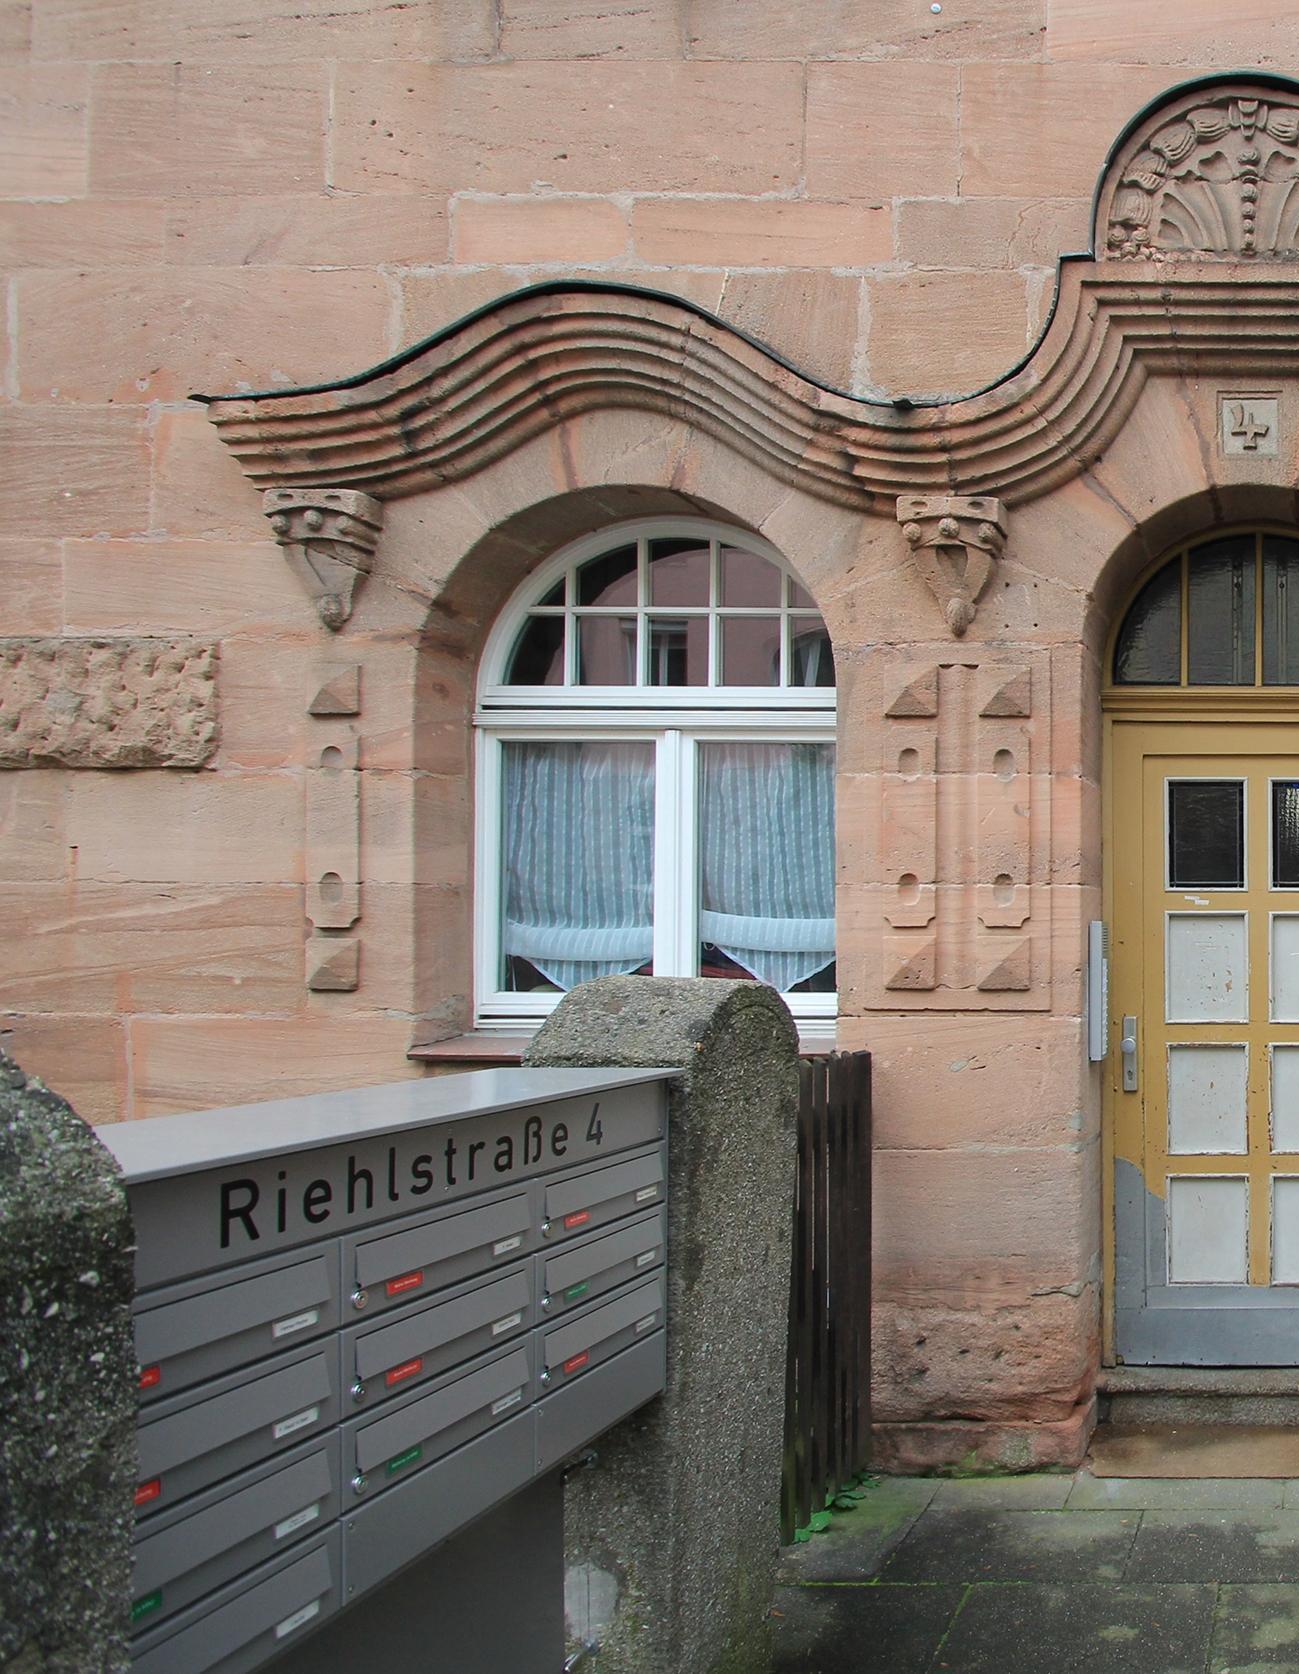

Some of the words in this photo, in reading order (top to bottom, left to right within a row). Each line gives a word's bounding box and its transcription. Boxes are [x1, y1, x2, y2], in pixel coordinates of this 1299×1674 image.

[1229, 403, 1269, 450] 4
[220, 1115, 569, 1249] Riehlstraße
[586, 1102, 603, 1146] 4
